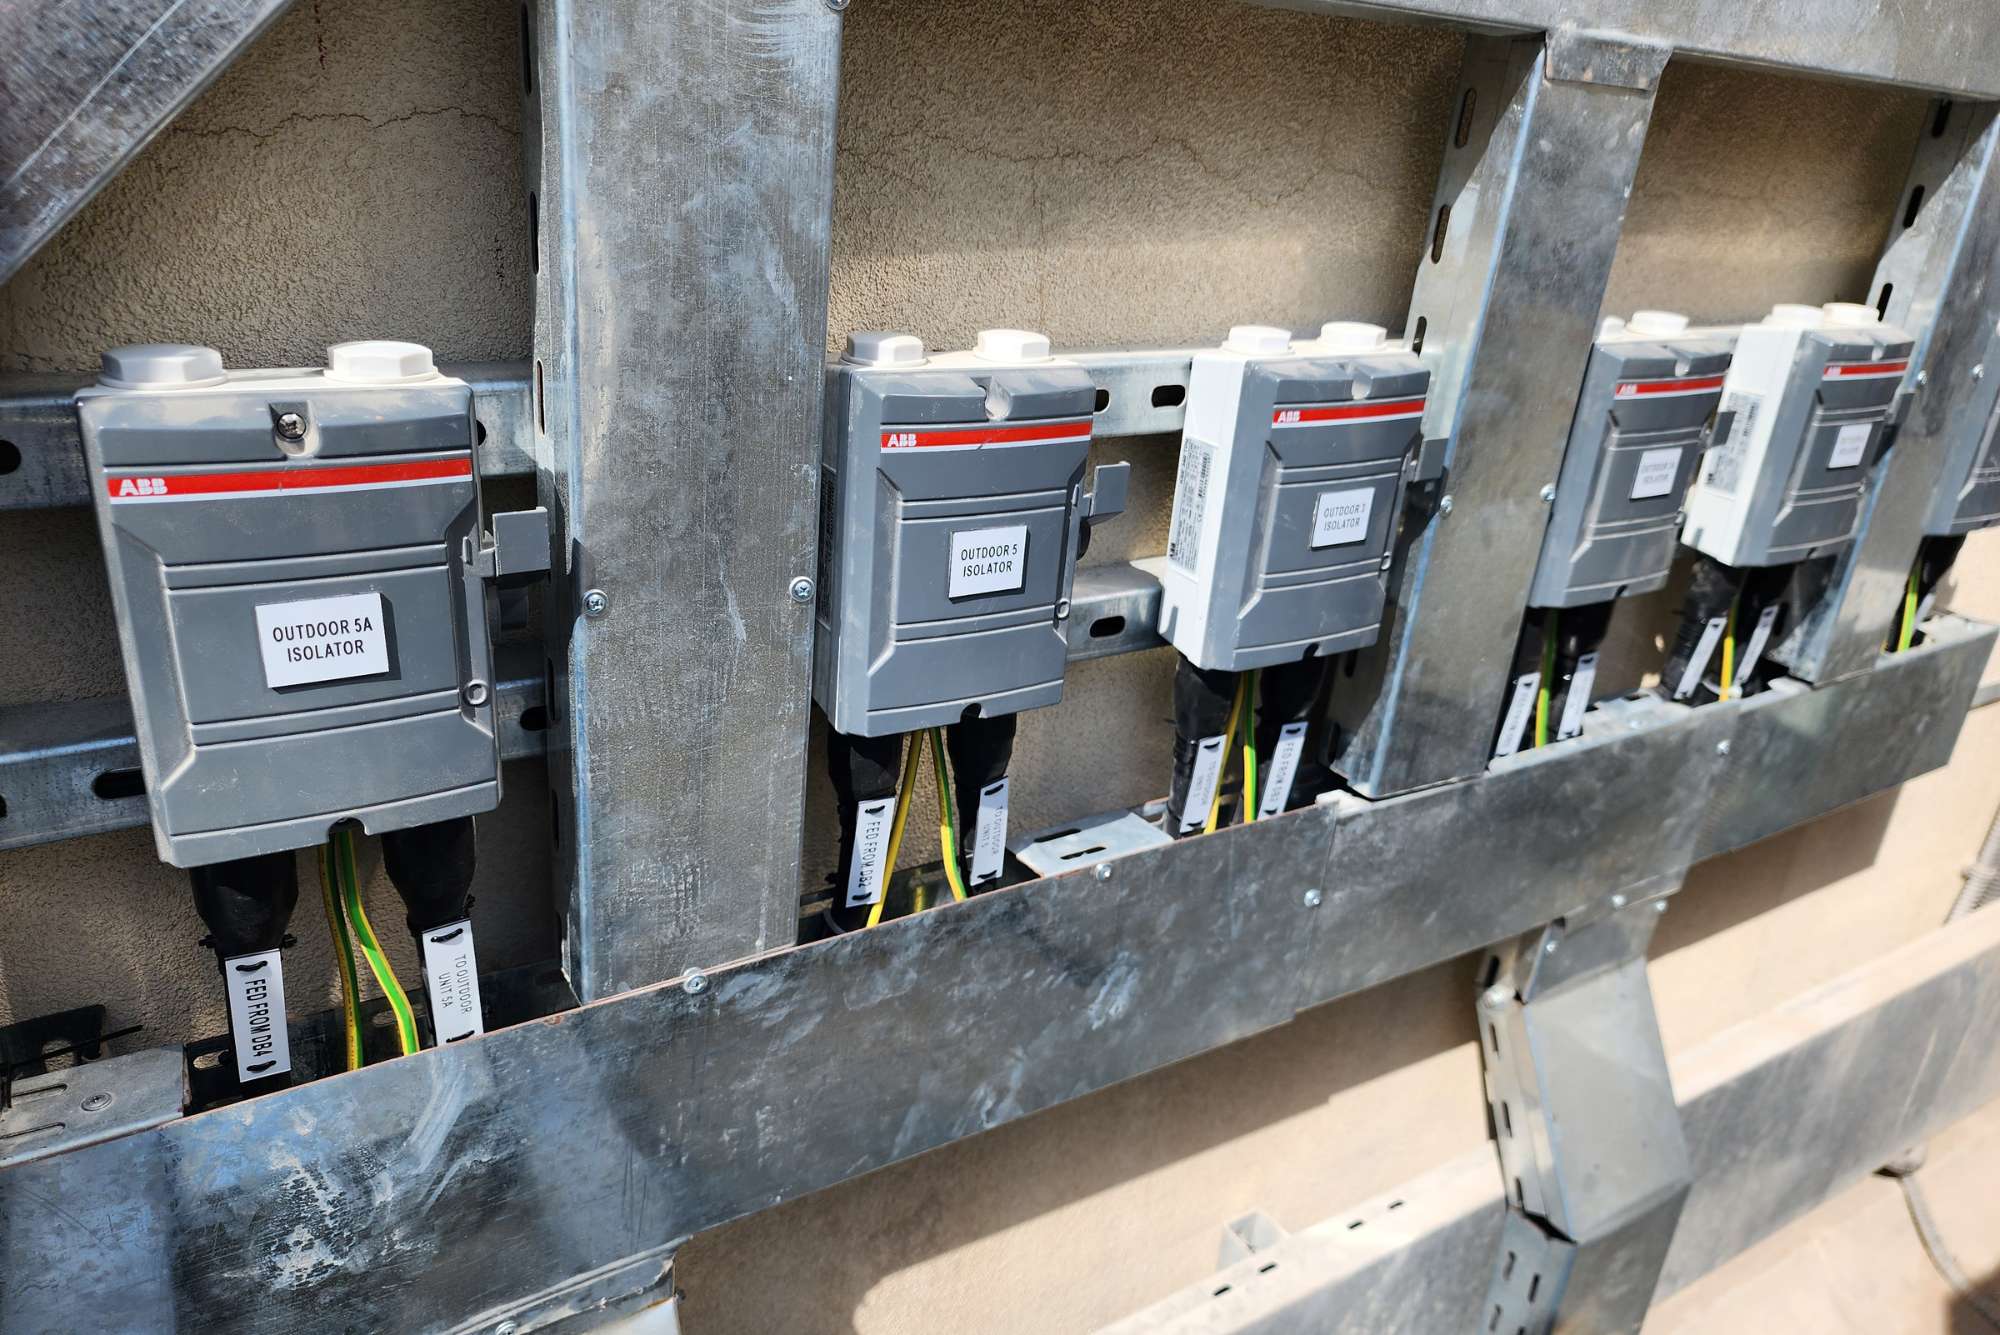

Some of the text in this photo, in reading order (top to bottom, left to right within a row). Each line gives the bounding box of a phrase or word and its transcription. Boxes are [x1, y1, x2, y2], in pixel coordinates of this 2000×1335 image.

[1278, 410, 1300, 423] ABB
[887, 433, 917, 448] ABB
[119, 478, 168, 497] ABB
[1323, 504, 1360, 518] OUTDOOR
[1323, 517, 1361, 531] ISOLATOR
[961, 543, 1018, 561] OUTDOOR 5
[962, 560, 1013, 577] ISOLATOR
[272, 617, 373, 642] OUTDOOR 5A
[287, 639, 365, 662] ISOLATOR
[865, 821, 881, 840] FED
[861, 842, 878, 868] FROM
[438, 971, 454, 1009] UNIT 5A
[454, 953, 473, 1015] TO OUTDOOR
[245, 978, 273, 1057] FED FROM DB4
